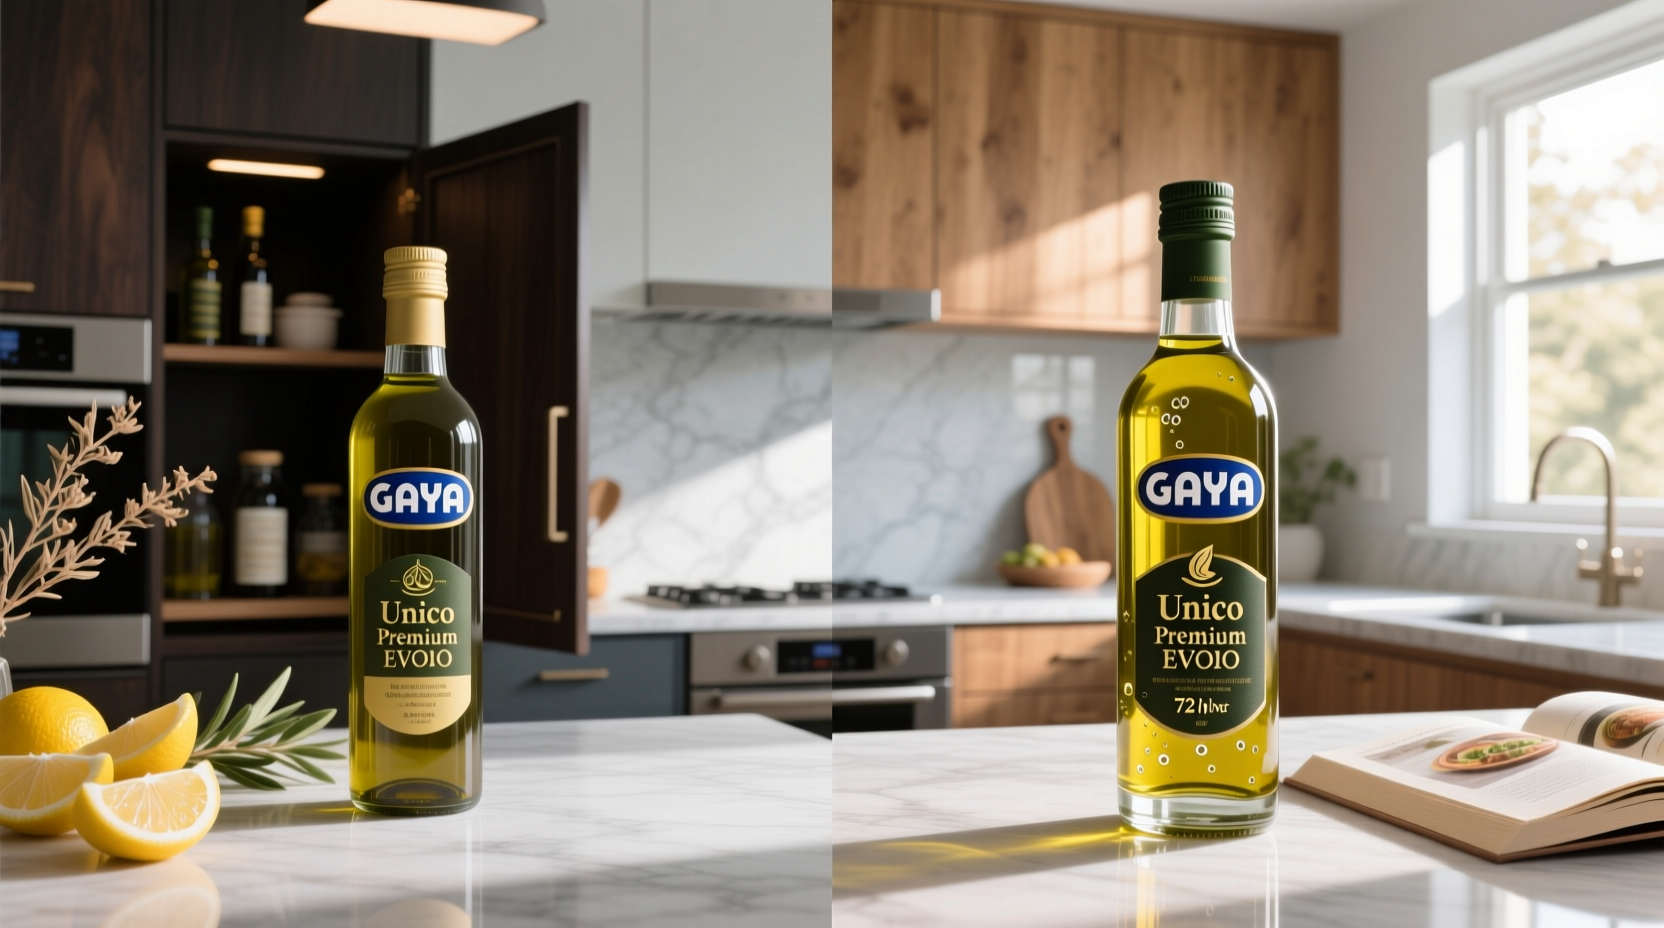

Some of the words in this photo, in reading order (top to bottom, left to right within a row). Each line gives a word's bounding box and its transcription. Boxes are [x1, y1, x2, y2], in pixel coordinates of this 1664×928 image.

[370, 482, 464, 514] GAYA
[1145, 471, 1254, 507] GAYA
[380, 600, 455, 624] Unico
[1157, 594, 1244, 621] Unico
[377, 627, 458, 646] Premium
[1154, 626, 1246, 645] Premium
